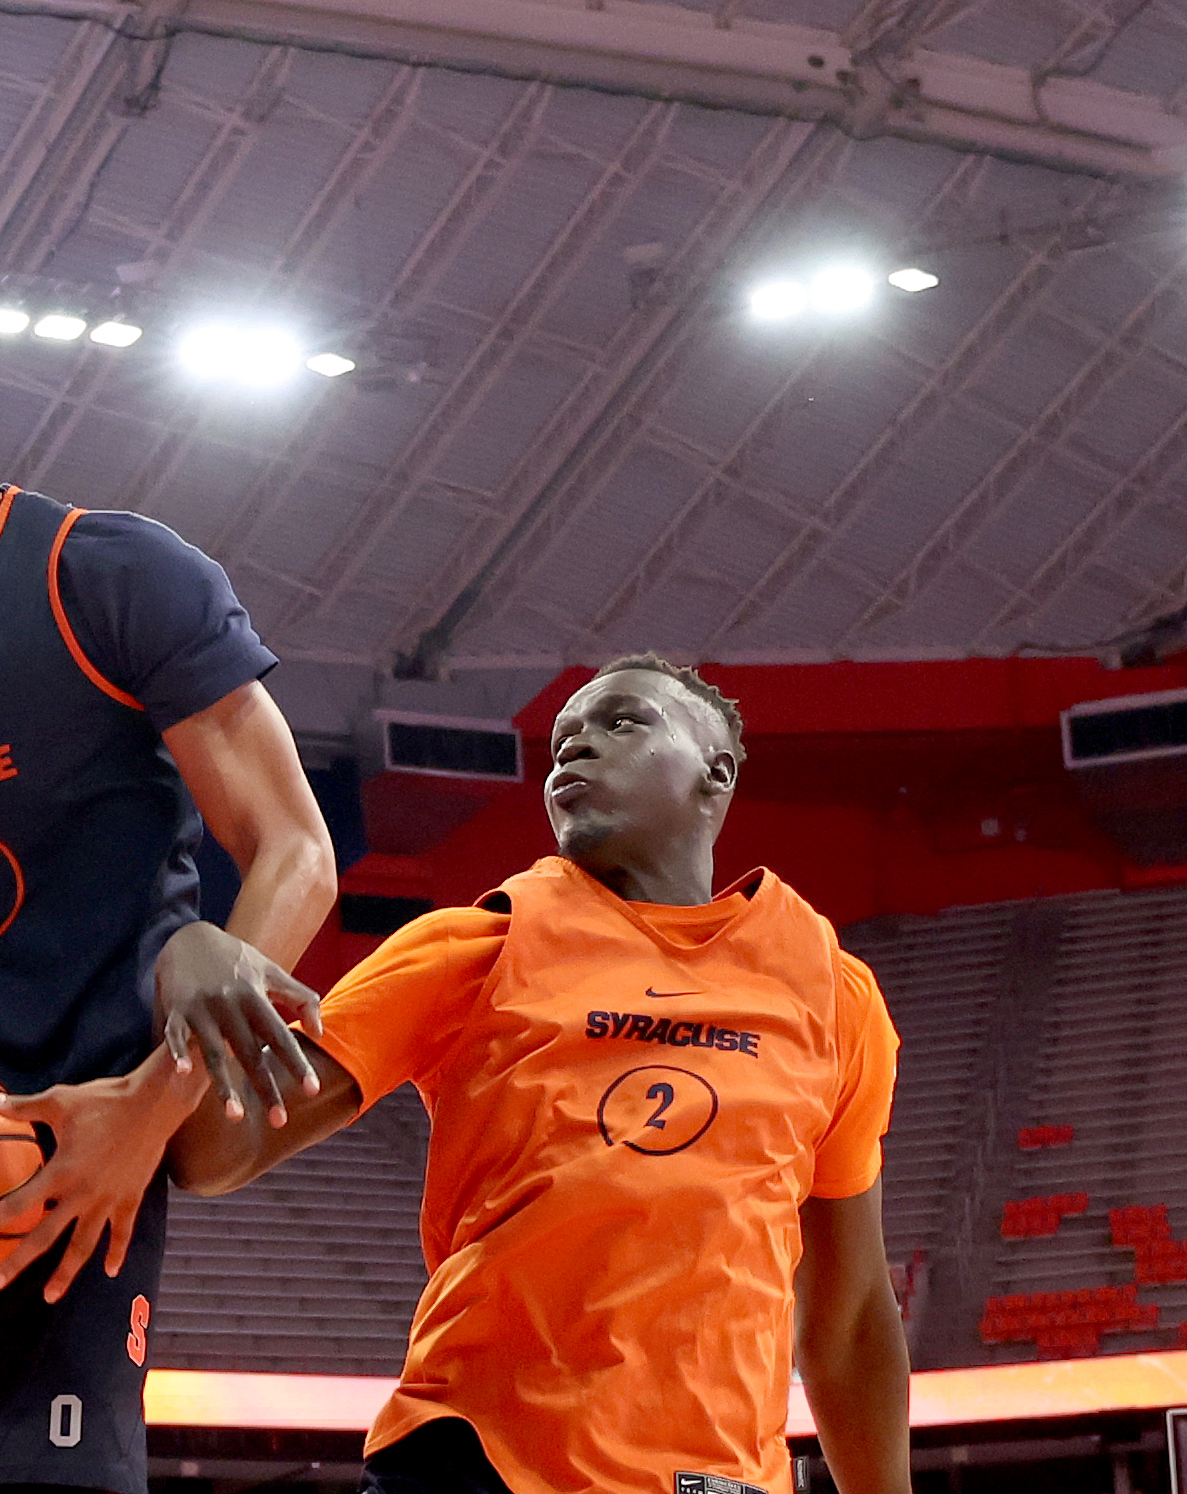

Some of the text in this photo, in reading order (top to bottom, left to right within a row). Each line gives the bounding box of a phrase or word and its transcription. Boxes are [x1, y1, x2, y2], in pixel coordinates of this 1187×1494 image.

[585, 1010, 761, 1058] SYRACUSE
[642, 1082, 675, 1130] 2
[48, 1394, 84, 1448] 0
